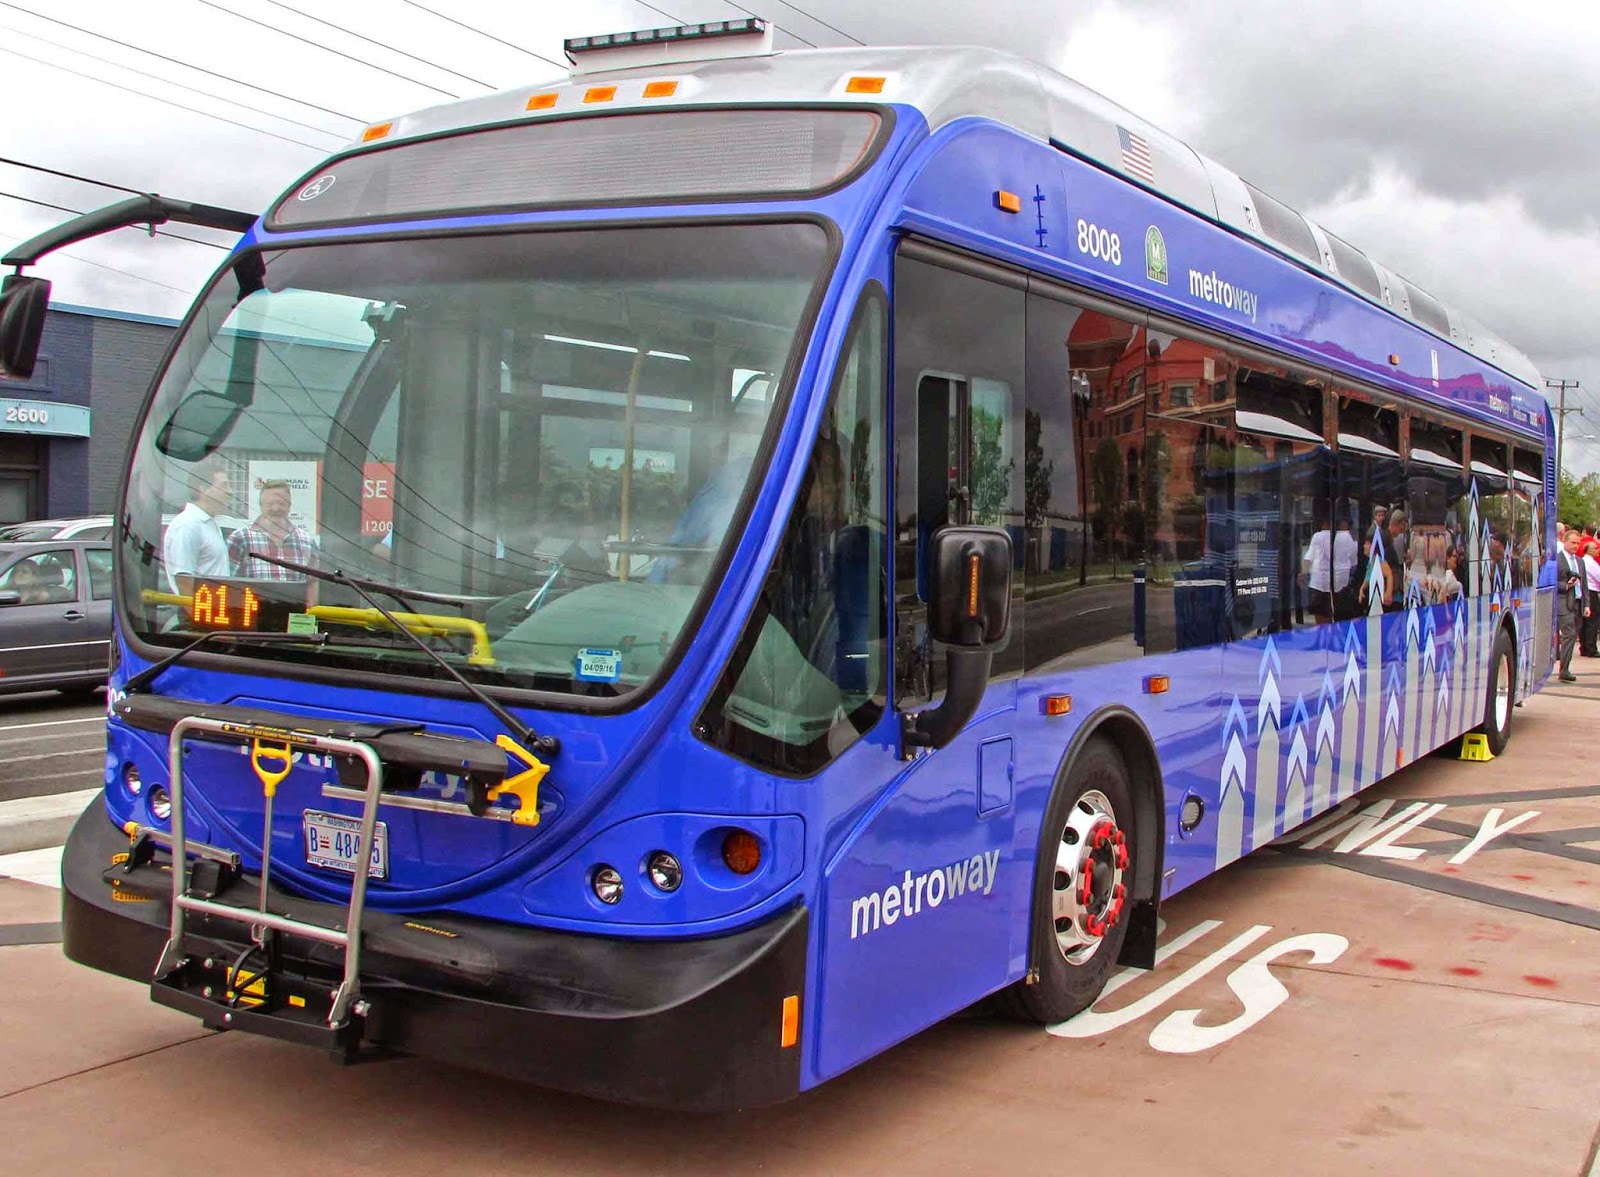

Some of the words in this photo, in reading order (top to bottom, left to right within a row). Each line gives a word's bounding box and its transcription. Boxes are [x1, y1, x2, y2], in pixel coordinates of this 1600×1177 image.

[1077, 219, 1122, 266] 8008
[1189, 269, 1258, 324] metroway
[6, 407, 48, 424] 2600
[363, 480, 387, 498] SE
[194, 584, 229, 625] A1
[310, 827, 318, 852] B
[335, 831, 380, 864] 4845
[851, 849, 1000, 939] metroway
[1045, 919, 1350, 1054] US
